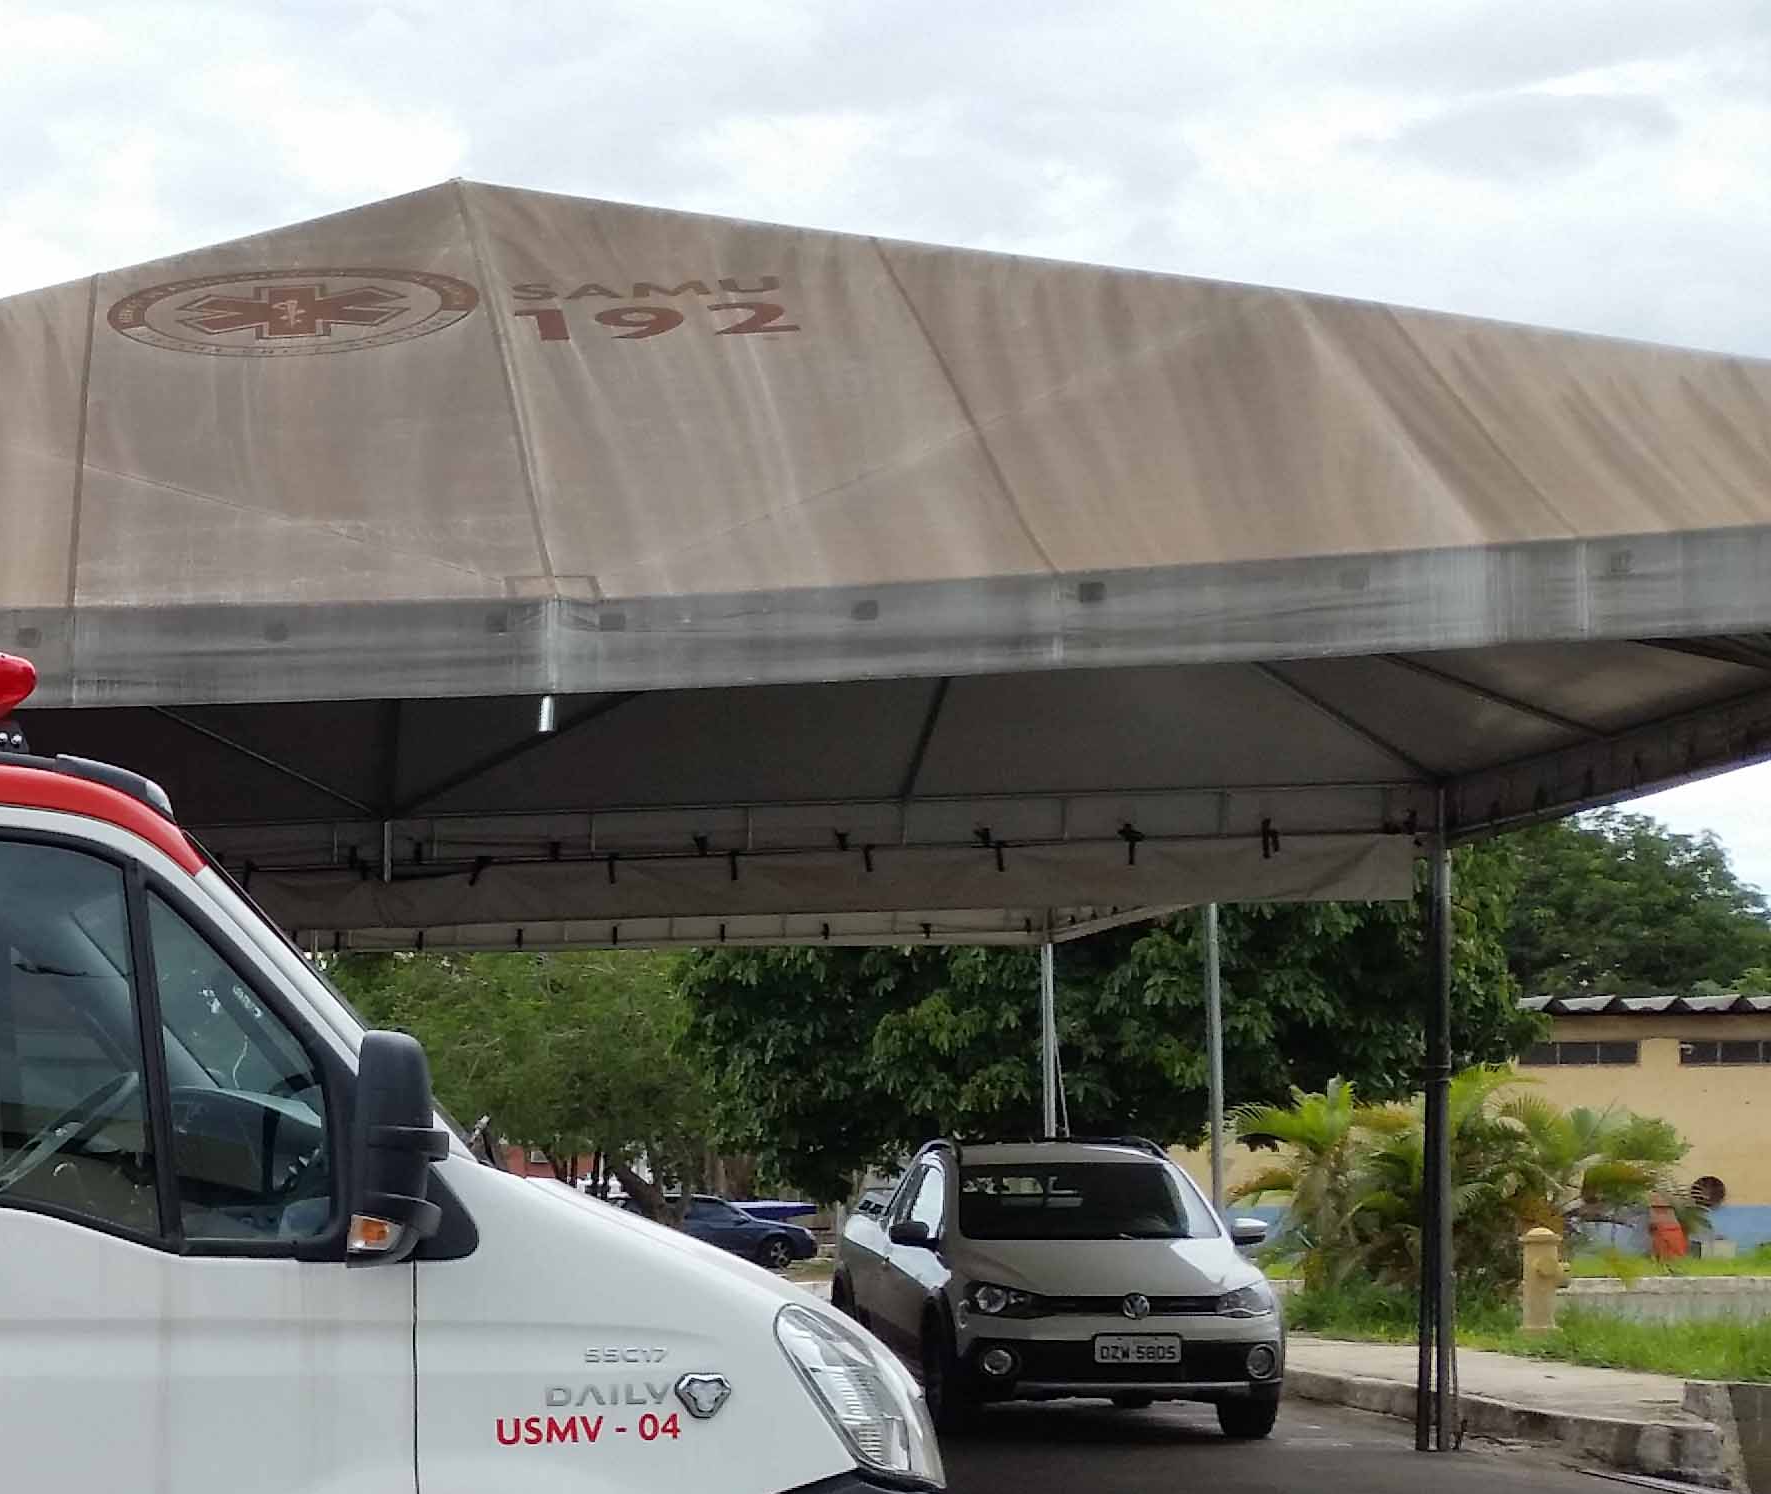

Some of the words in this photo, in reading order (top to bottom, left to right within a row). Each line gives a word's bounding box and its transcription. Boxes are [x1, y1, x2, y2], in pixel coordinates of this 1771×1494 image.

[512, 276, 781, 300] SAMU
[514, 302, 801, 341] 192
[545, 1382, 672, 1407] DAILY
[496, 1415, 605, 1446] USMV
[637, 1412, 681, 1441] 04
